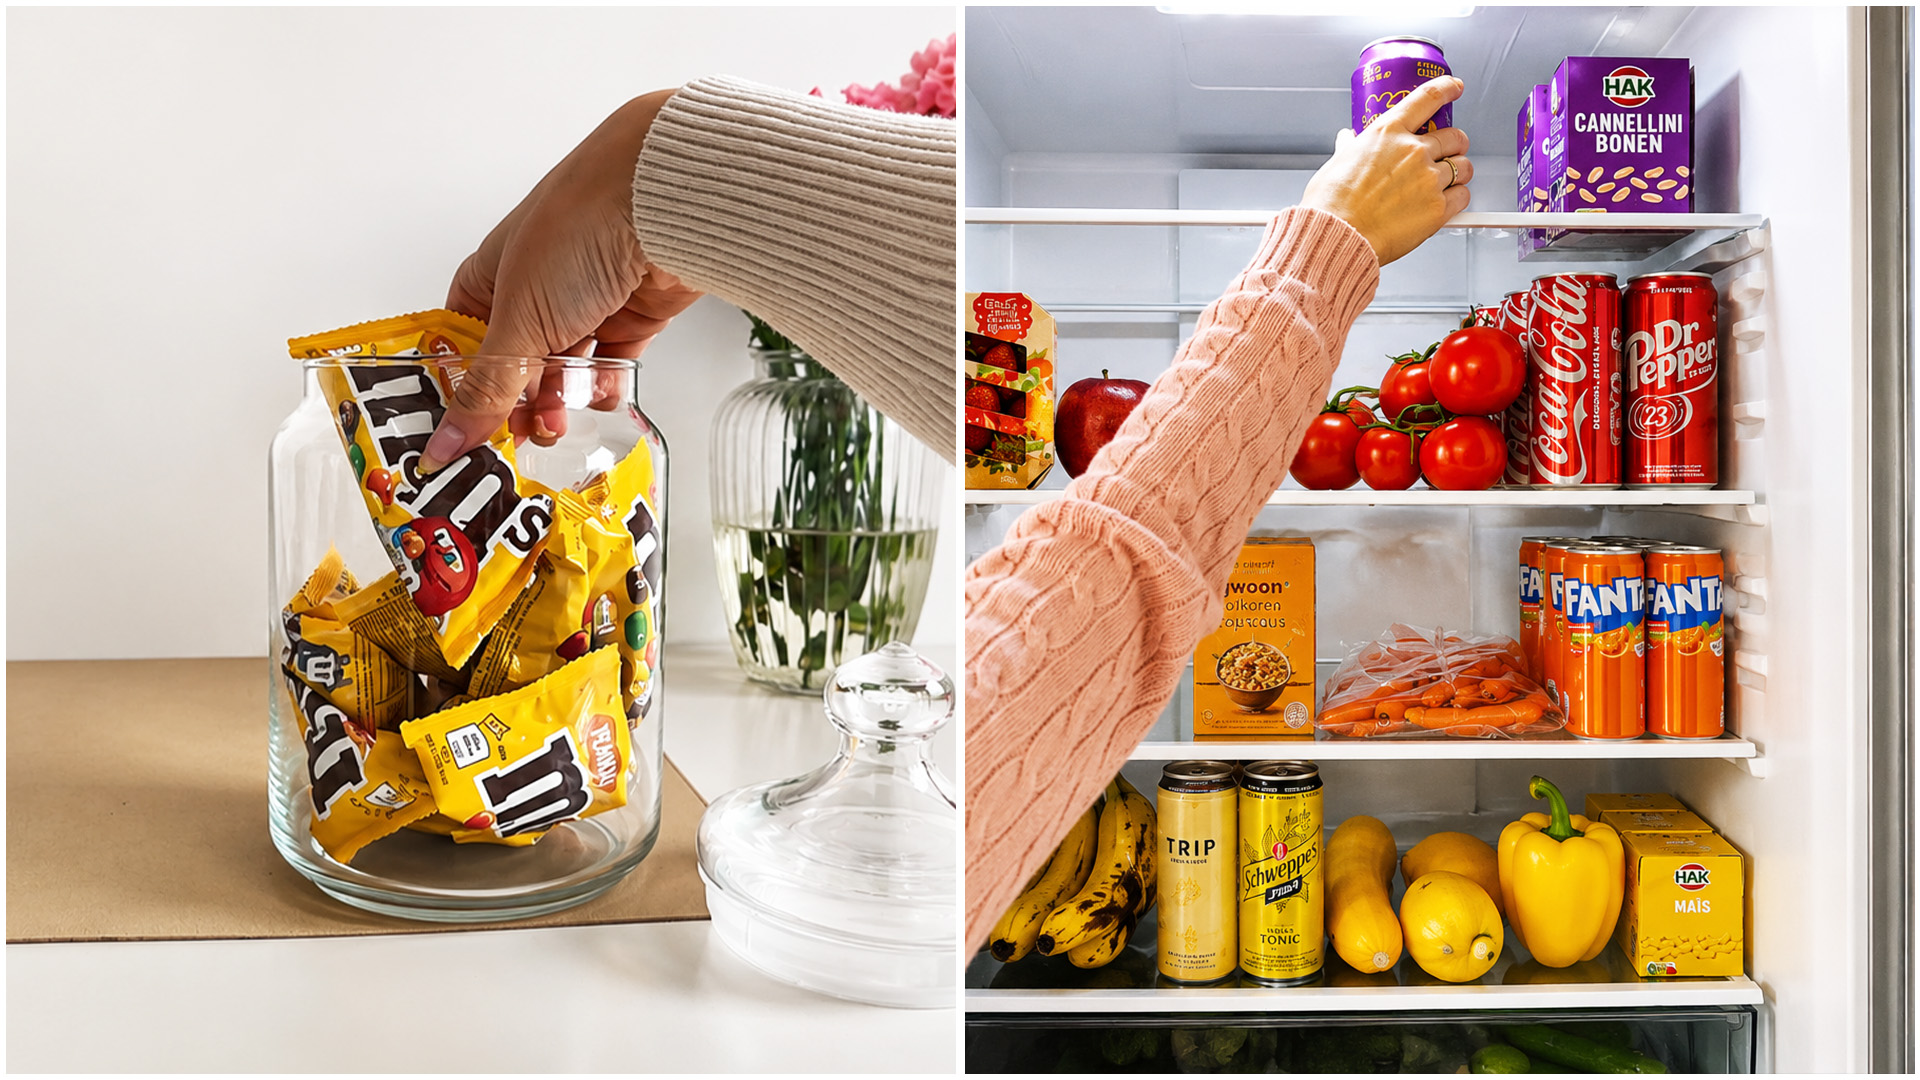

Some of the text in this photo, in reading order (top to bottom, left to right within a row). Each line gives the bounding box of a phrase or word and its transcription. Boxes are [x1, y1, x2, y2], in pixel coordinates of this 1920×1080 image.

[1603, 77, 1654, 97] HAK
[1573, 112, 1683, 134] CANNELLINI
[1595, 133, 1663, 154] BONEN
[1653, 319, 1700, 357] Dr
[1624, 330, 1716, 393] Pepper
[1643, 405, 1668, 427] 23
[1225, 599, 1281, 611] olkoren
[1166, 836, 1216, 857] TRIP
[1244, 841, 1318, 892] Schweppes
[1675, 870, 1710, 884] HAK
[1260, 933, 1301, 945] TONIC
